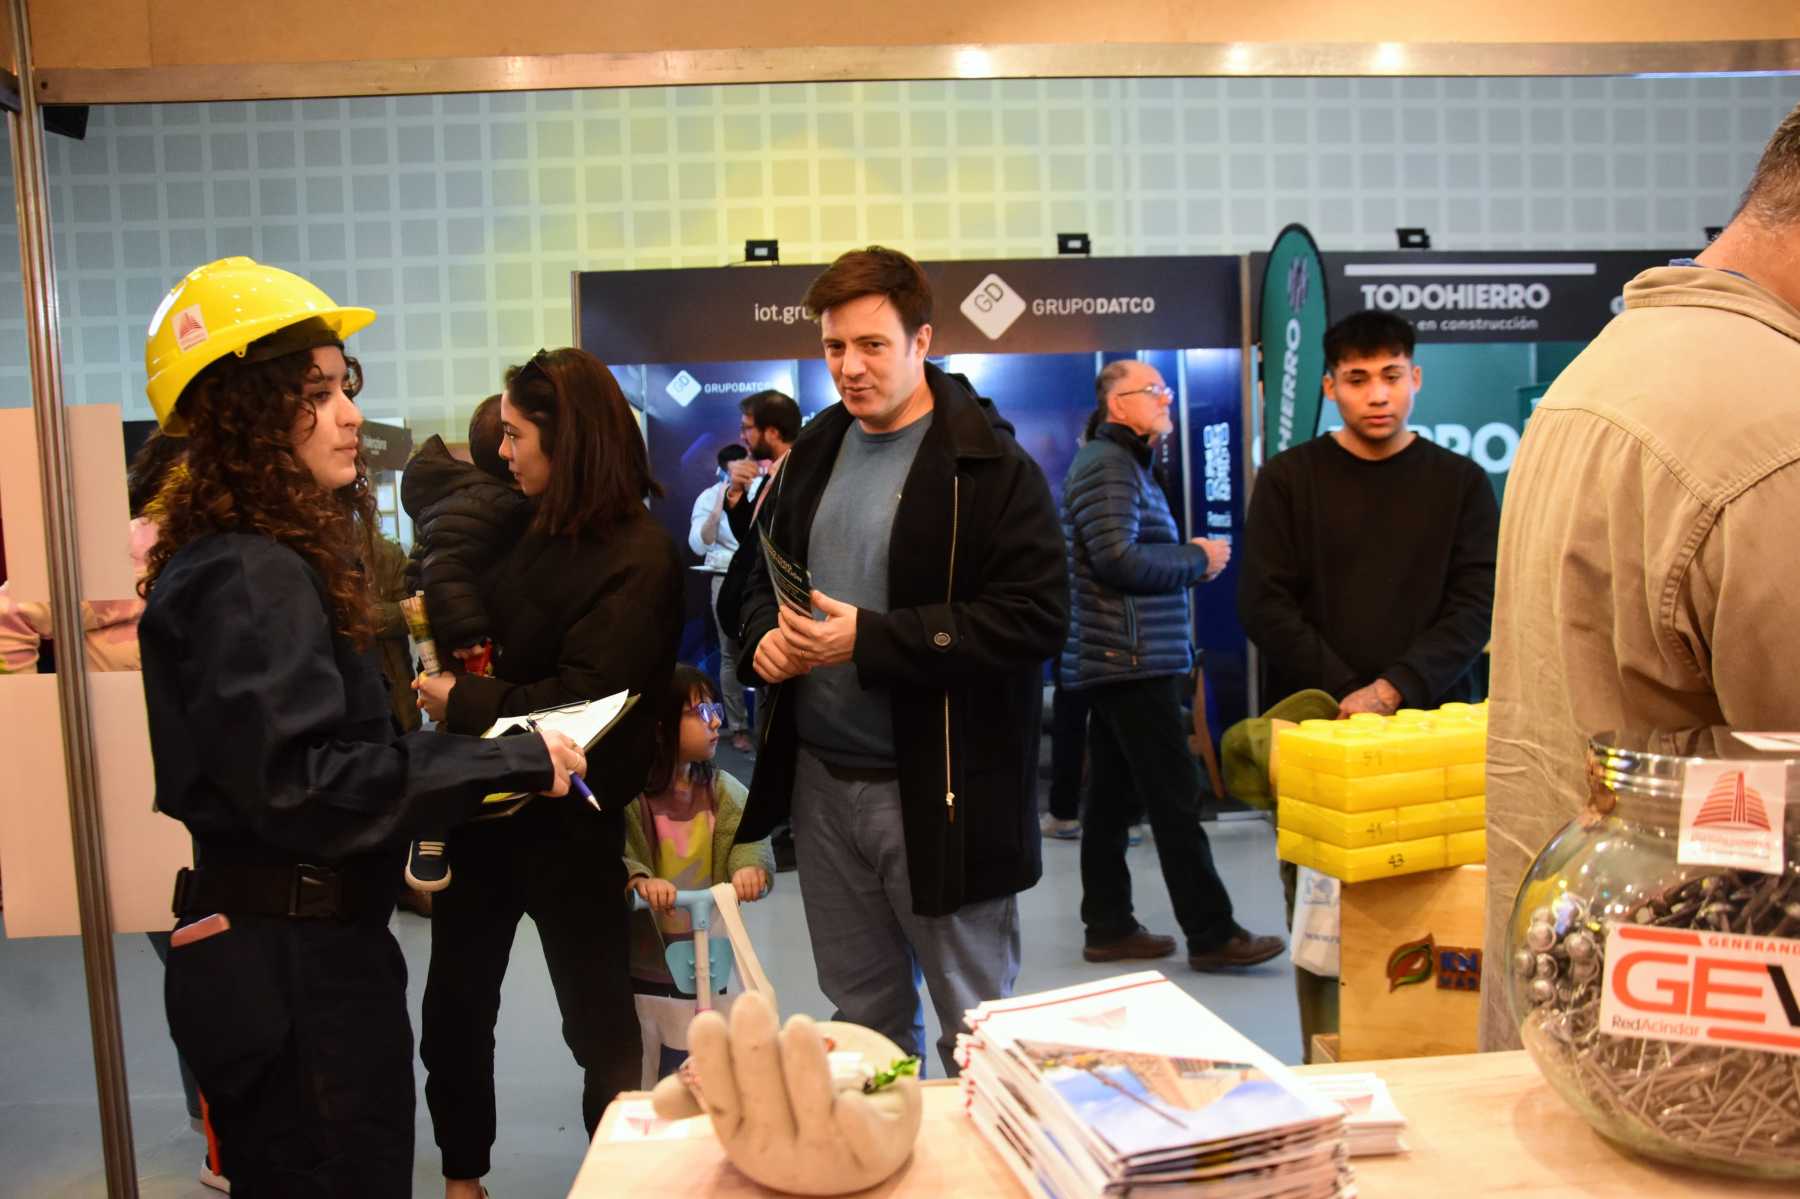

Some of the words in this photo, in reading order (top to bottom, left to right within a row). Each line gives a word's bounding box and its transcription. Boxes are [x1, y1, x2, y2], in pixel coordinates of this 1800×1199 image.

[974, 282, 1004, 314] GD
[1032, 297, 1155, 316] GRUPODATCO
[1361, 283, 1551, 310] TODOHIERRO
[1417, 319, 1437, 331] en
[1440, 314, 1539, 331] construcción
[1611, 1015, 1700, 1037] RedAcindar
